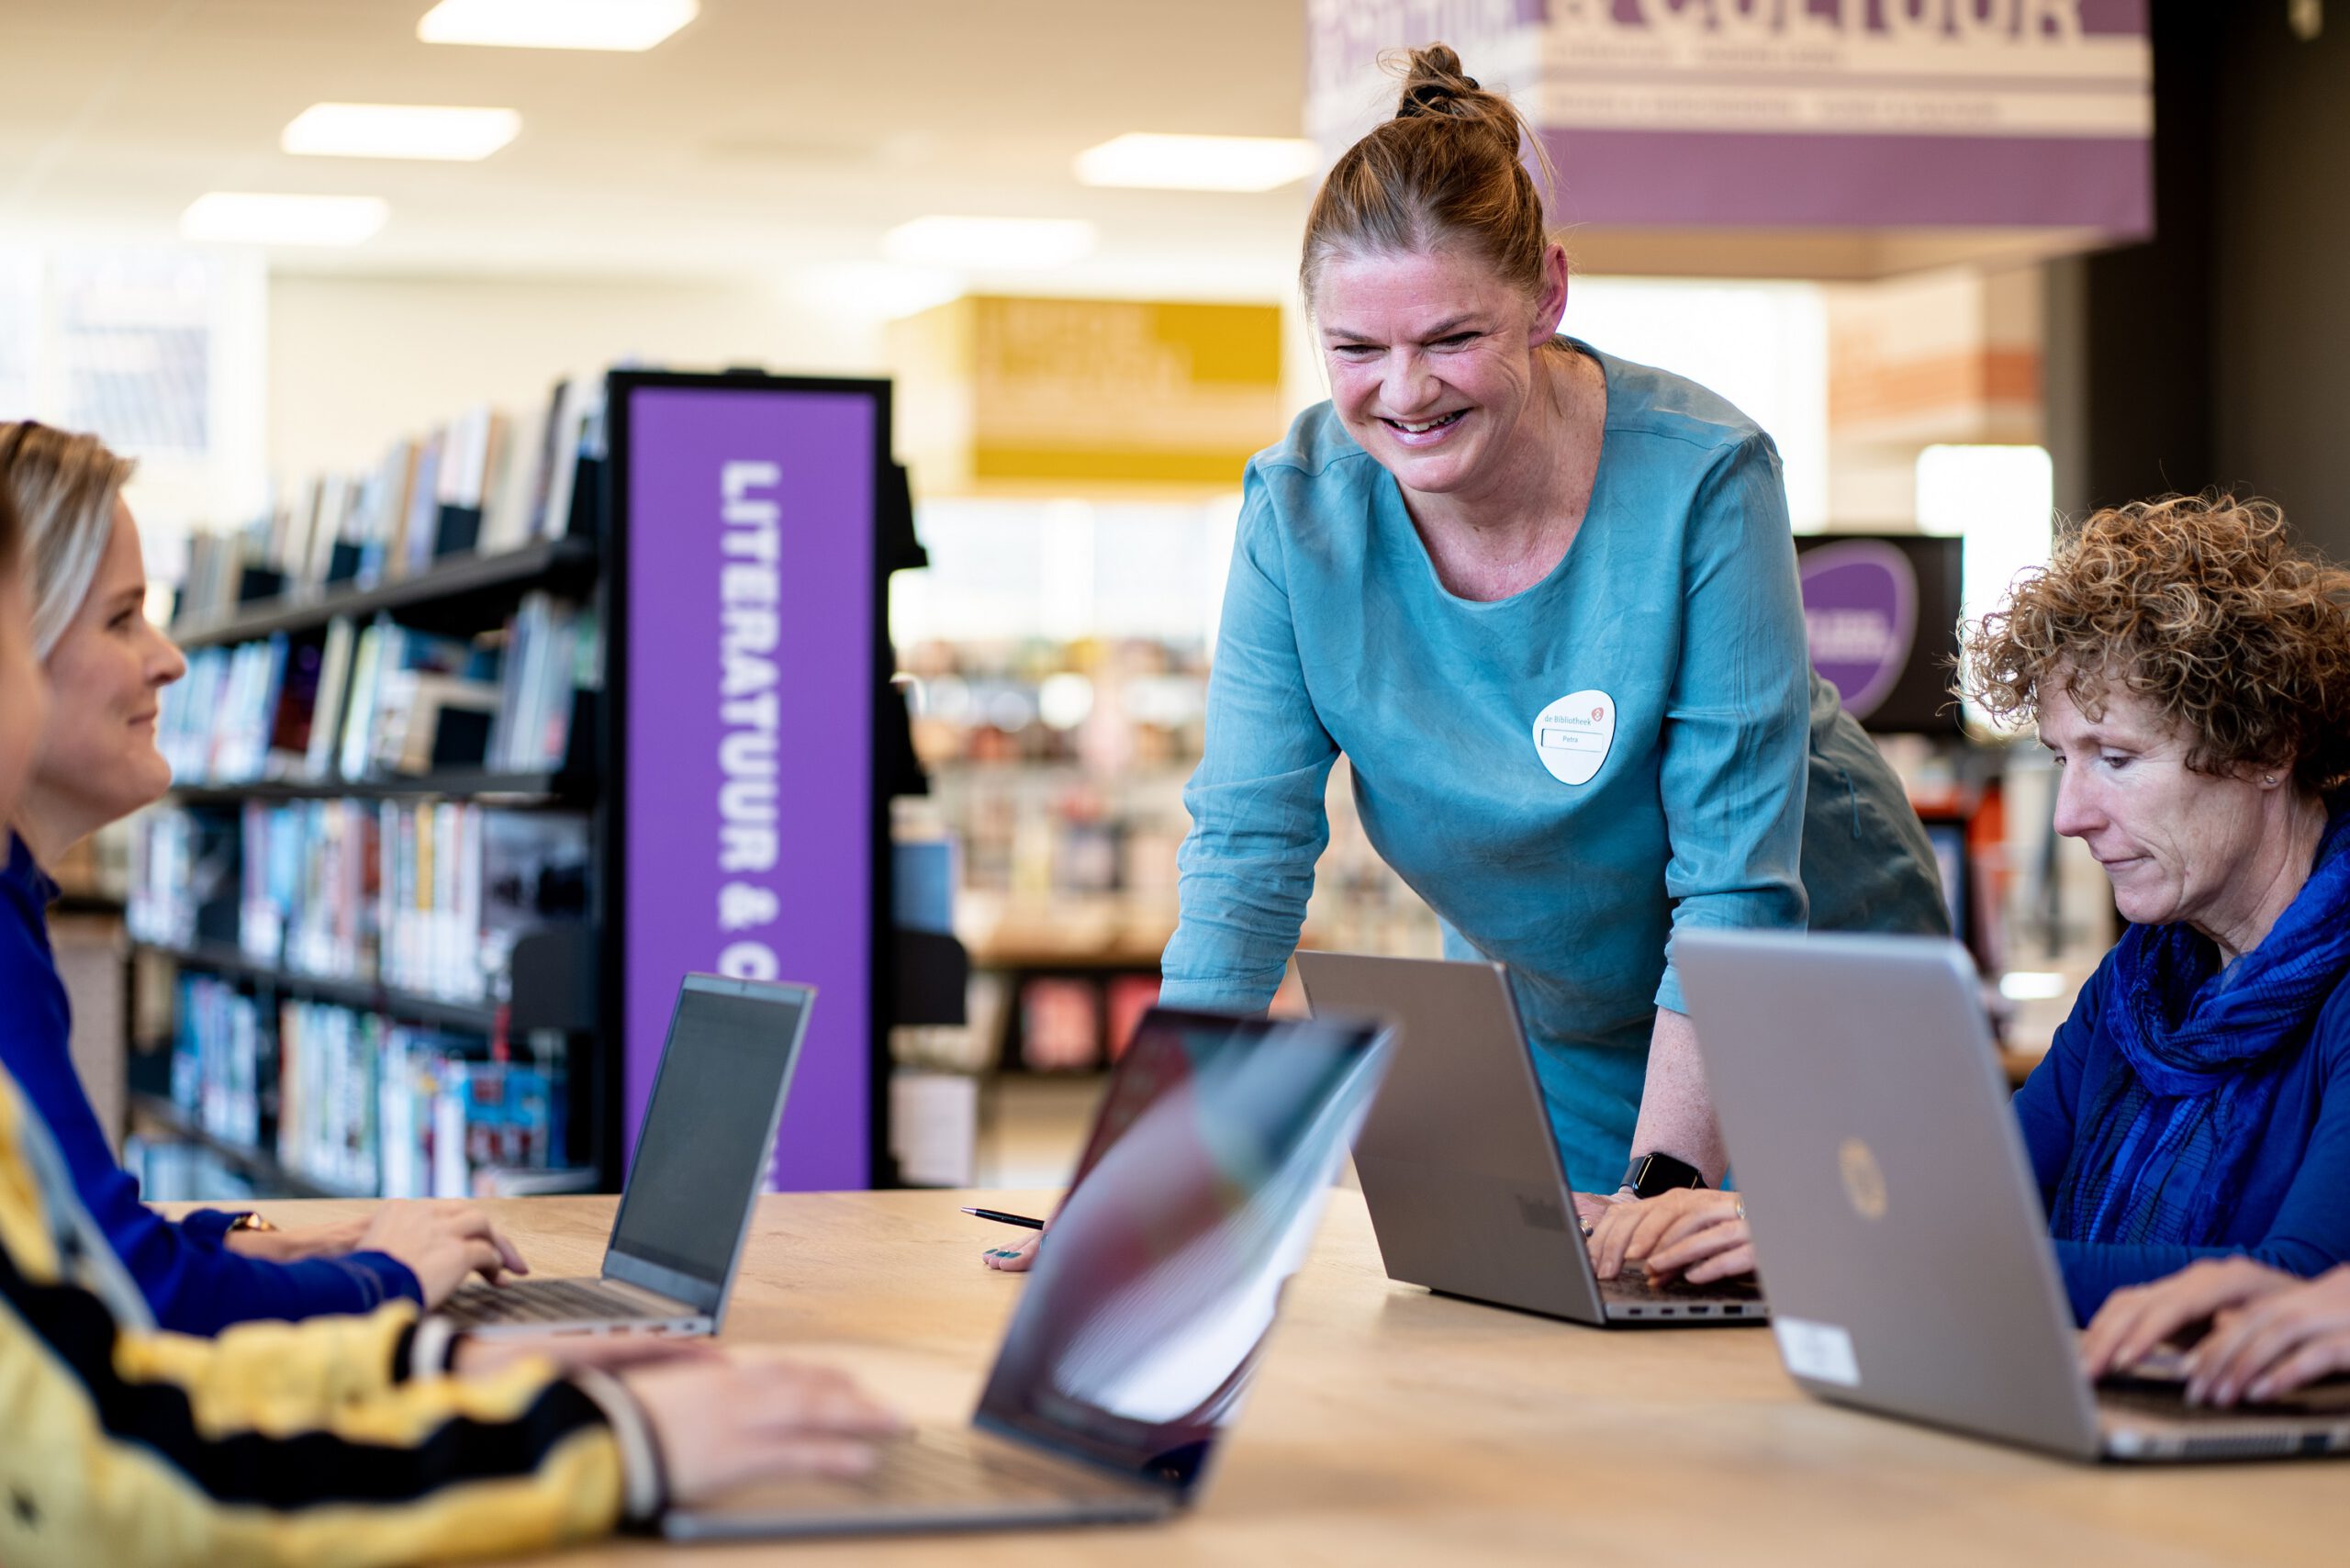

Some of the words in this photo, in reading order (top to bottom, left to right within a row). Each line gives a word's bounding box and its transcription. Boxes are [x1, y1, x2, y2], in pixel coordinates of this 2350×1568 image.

[720, 460, 780, 871] LITERATUUR
[1544, 714, 1553, 722] de
[1554, 715, 1592, 726] Bibliotheek
[719, 880, 779, 933] &
